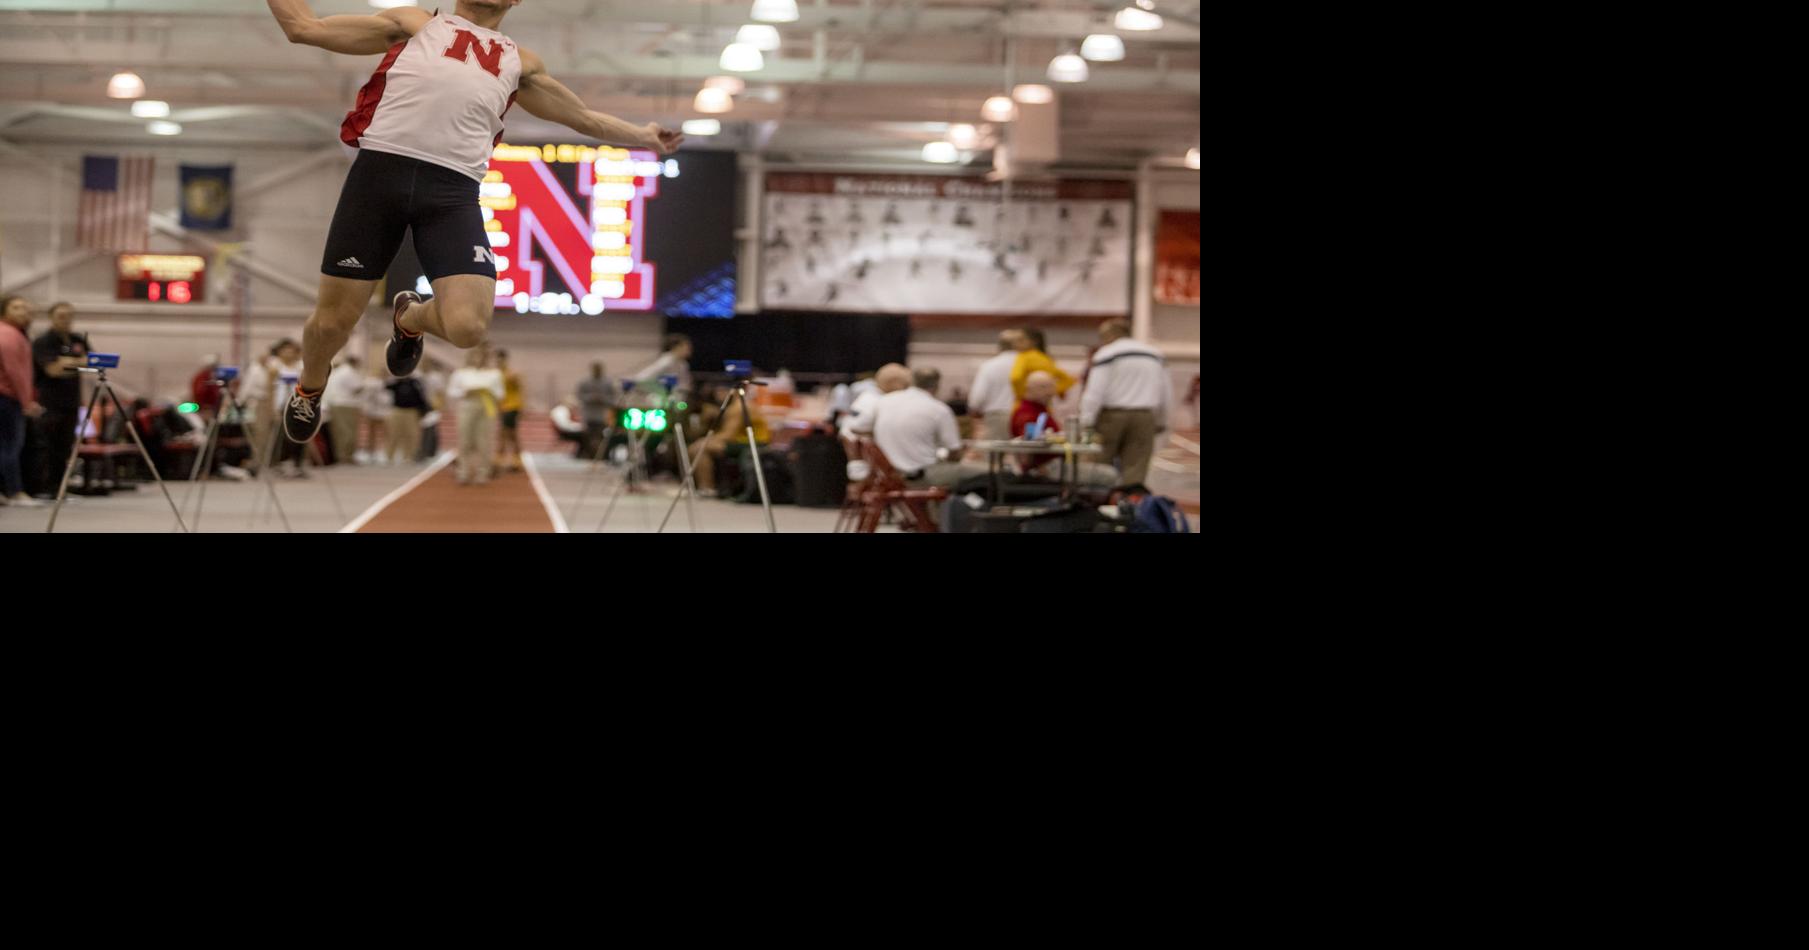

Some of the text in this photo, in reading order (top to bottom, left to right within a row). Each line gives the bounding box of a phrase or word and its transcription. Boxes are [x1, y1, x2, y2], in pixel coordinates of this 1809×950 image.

[442, 28, 505, 79] N
[473, 245, 496, 265] N
[482, 150, 658, 311] N
